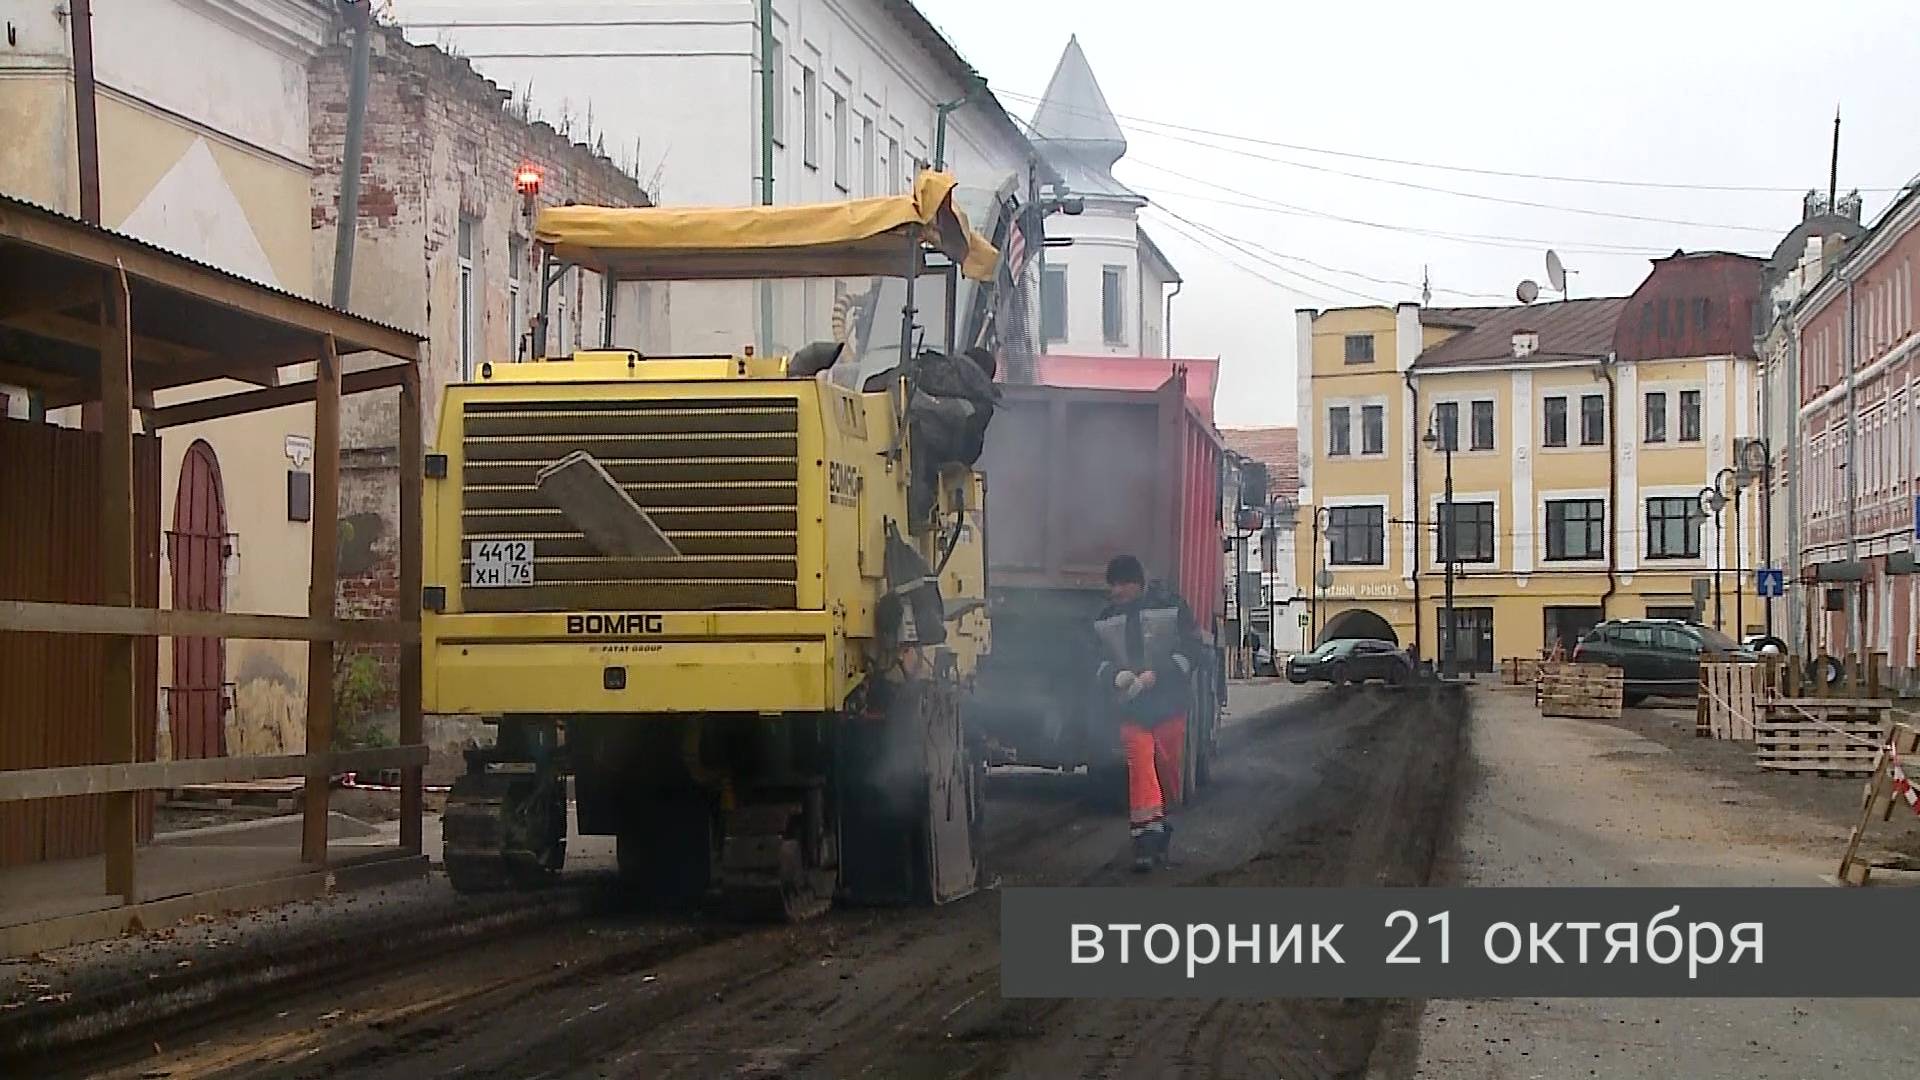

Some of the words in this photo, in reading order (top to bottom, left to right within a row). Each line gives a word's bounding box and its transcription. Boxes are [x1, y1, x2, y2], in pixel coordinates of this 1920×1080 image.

[479, 543, 526, 561] 4412
[511, 564, 529, 579] 76
[567, 614, 662, 634] BOMAG
